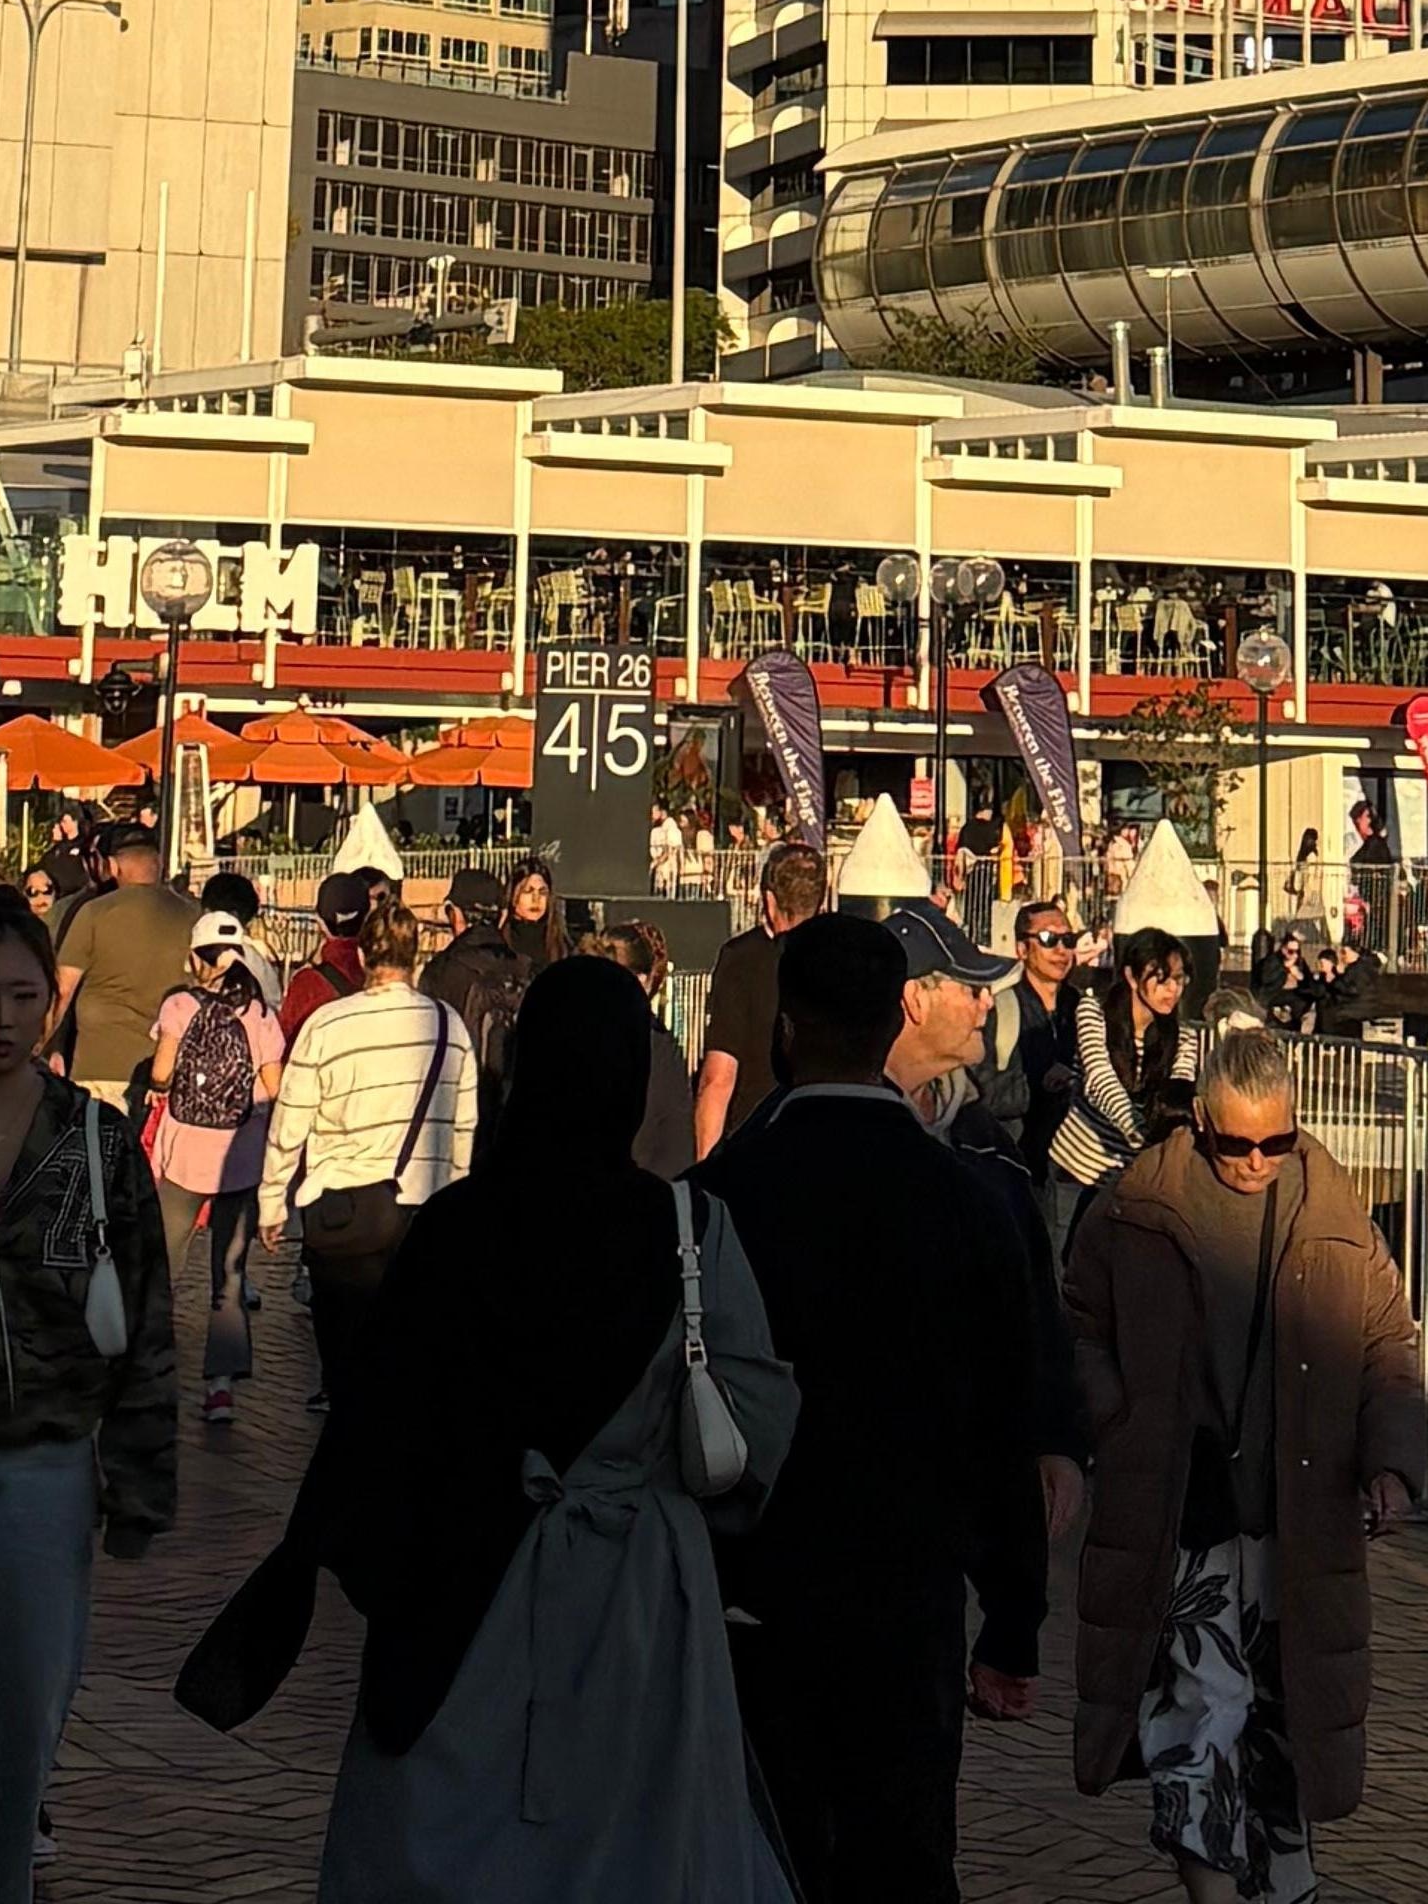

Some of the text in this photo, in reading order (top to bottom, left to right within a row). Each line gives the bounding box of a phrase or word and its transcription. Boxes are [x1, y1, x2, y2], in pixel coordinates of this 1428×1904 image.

[546, 651, 652, 688] PIER 26
[542, 702, 648, 777] 4 5
[783, 747, 801, 779] the
[1034, 757, 1055, 788] the
